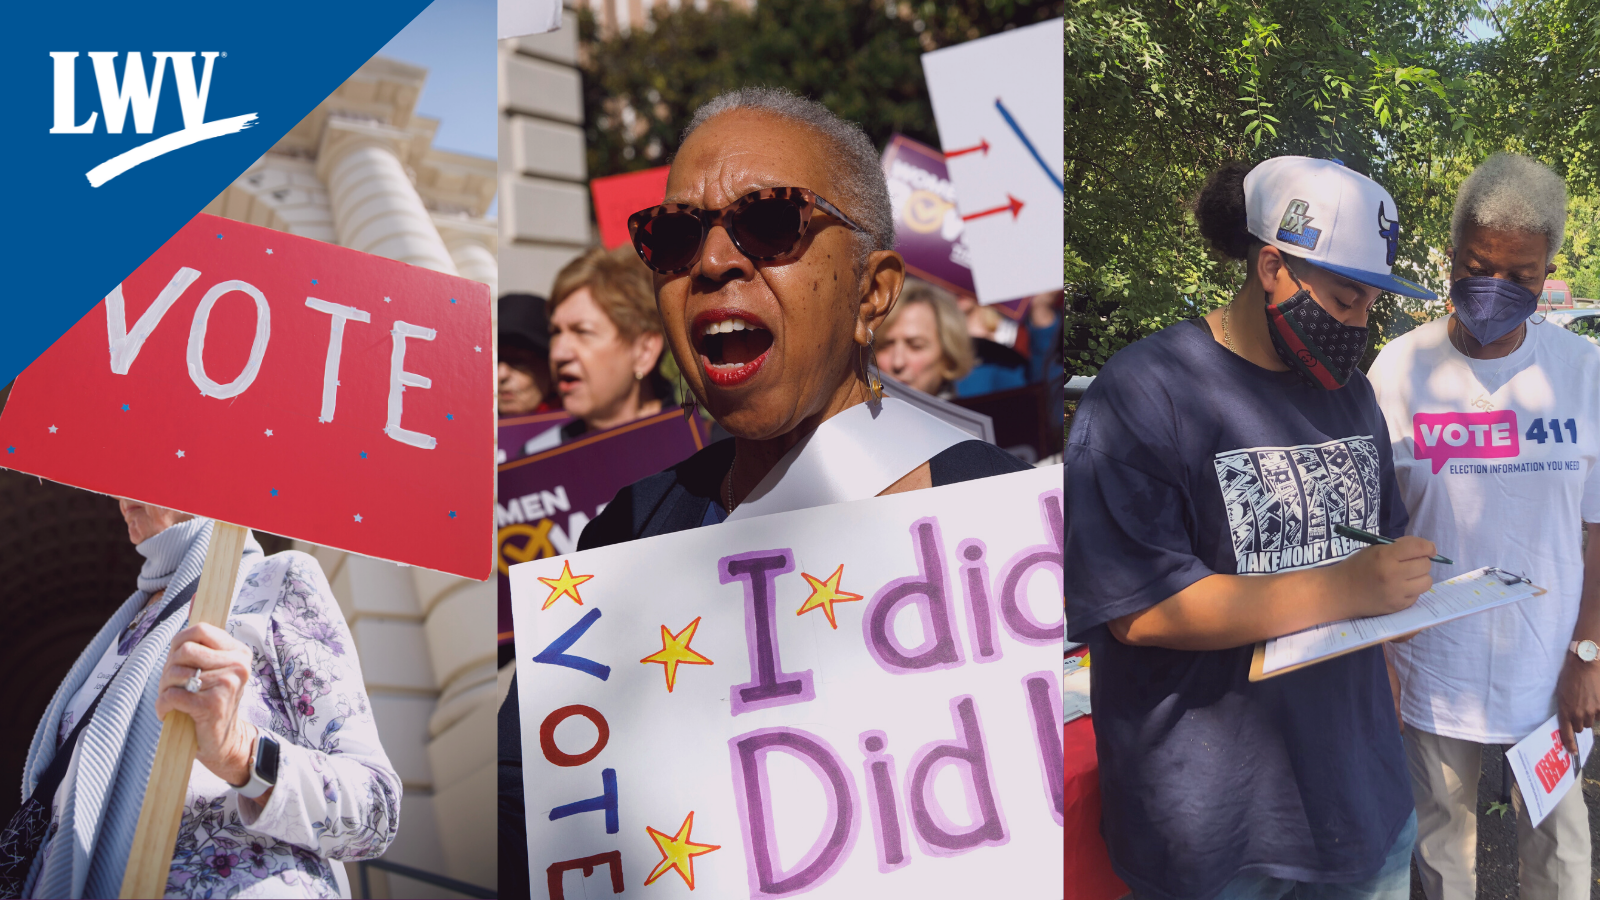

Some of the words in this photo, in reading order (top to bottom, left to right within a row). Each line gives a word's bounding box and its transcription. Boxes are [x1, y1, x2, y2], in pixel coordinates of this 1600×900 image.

[1277, 229, 1315, 248] CHAMPIONS
[1303, 226, 1318, 239] NBA
[105, 267, 436, 450] VOTE
[1471, 391, 1494, 414] VOTE
[1420, 422, 1512, 447] VOTE
[1525, 418, 1577, 444] 411
[1450, 464, 1488, 474] ELECTION
[1490, 461, 1545, 474] INFORMATION
[1547, 461, 1563, 471] YOU
[1564, 460, 1580, 471] NEED
[1280, 541, 1329, 568] MONEY
[718, 548, 816, 717] I
[862, 489, 1063, 675] did
[533, 608, 625, 900] VOTE
[728, 694, 1010, 900] Did
